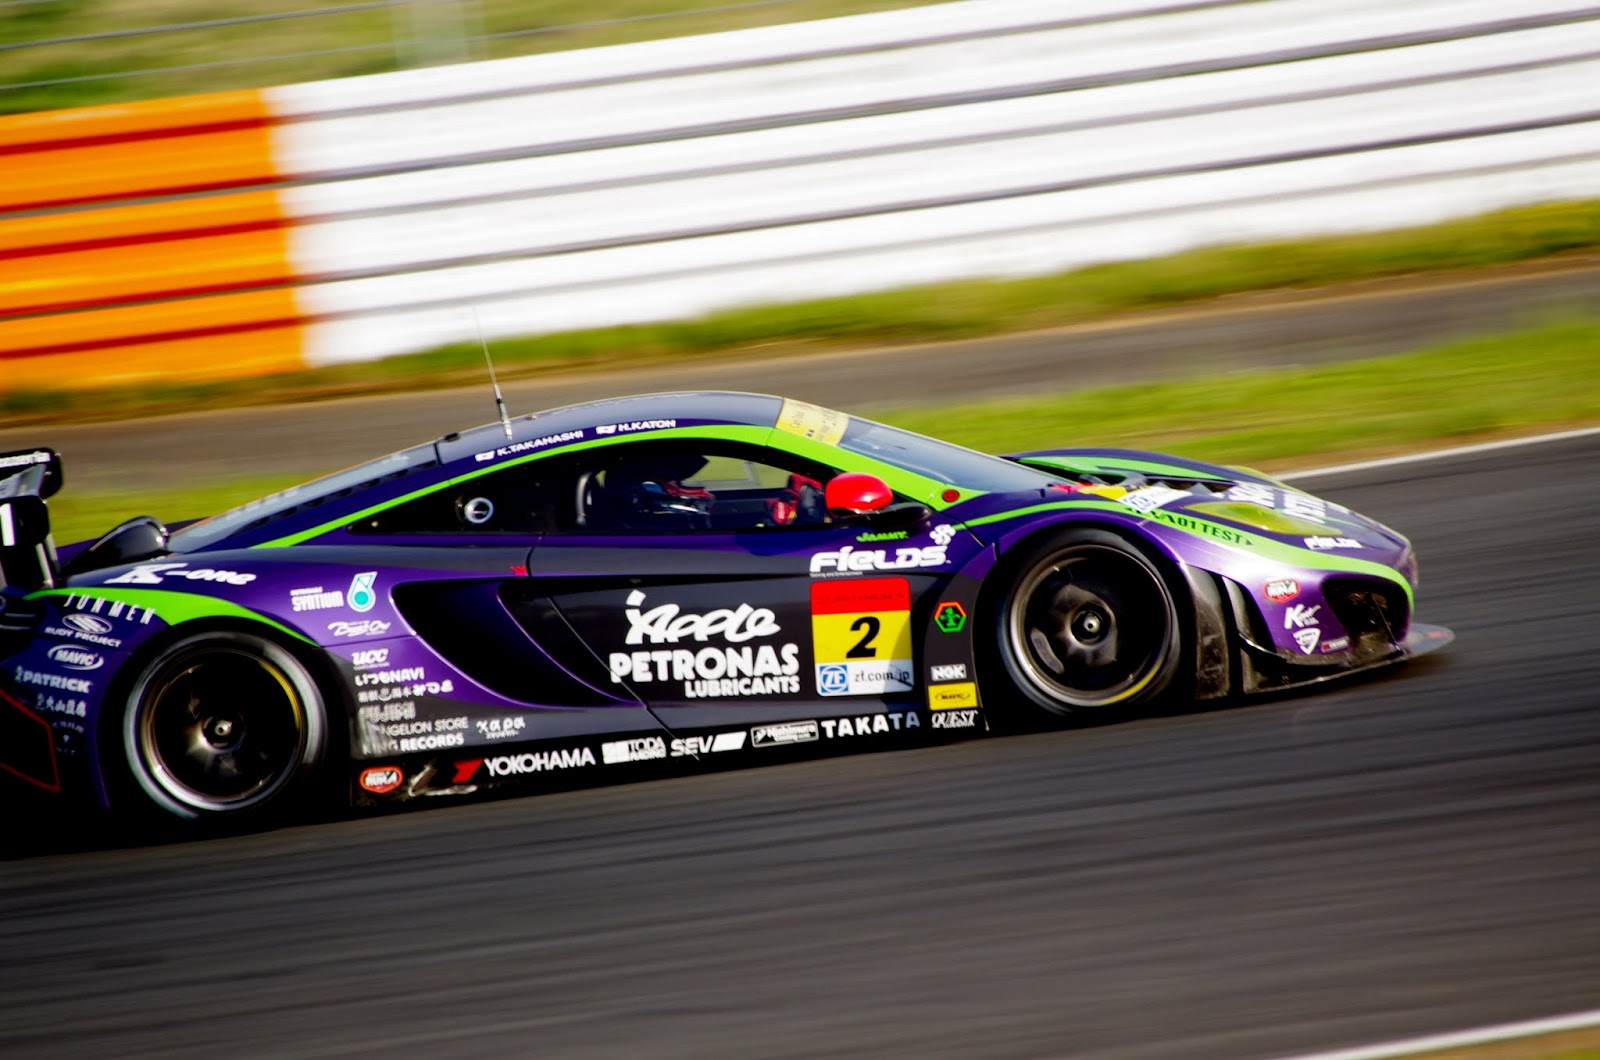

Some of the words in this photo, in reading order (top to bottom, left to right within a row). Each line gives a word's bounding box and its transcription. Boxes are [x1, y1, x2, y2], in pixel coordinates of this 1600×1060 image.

[618, 420, 676, 431] H.KATOH
[497, 430, 584, 456] K.TAKAHASHI
[1201, 523, 1244, 545] TEST
[74, 632, 122, 648] PROJECT
[846, 616, 881, 659] 2
[352, 649, 389, 665] UCC
[609, 643, 800, 683] PETRONAS
[23, 670, 92, 693] PATRICK
[684, 675, 801, 699] LUBRICANTS
[821, 711, 921, 739] TAKATA
[400, 732, 464, 752] RECORDS
[628, 736, 665, 751] TODA
[484, 746, 596, 777] YOKOHAMA
